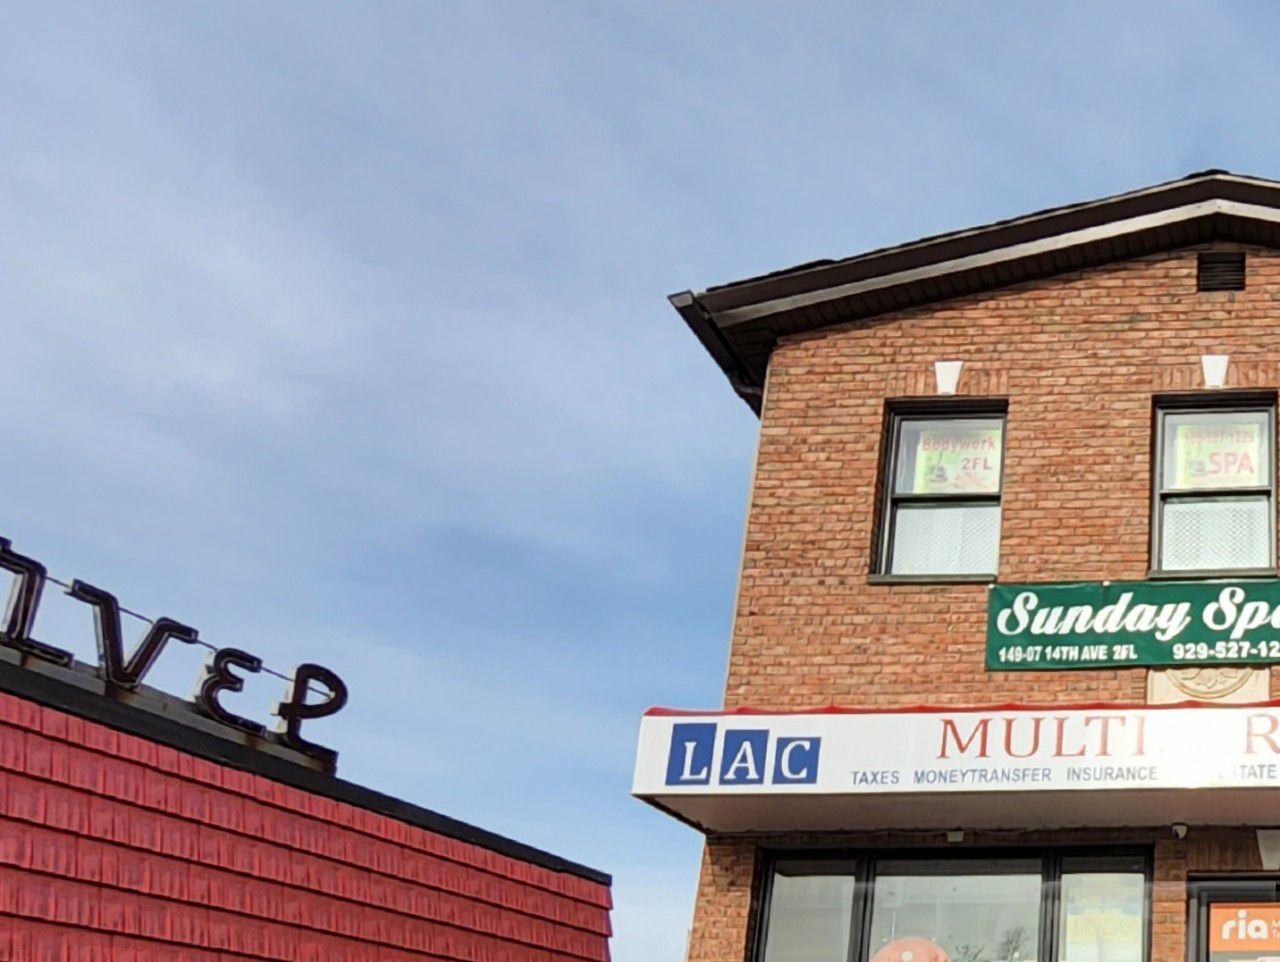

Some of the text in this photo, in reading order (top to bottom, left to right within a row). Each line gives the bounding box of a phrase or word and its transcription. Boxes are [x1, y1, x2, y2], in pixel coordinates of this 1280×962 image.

[961, 457, 993, 471] 2FL
[1209, 450, 1255, 474] SPA
[996, 591, 1192, 642] Sunday
[998, 645, 1043, 662] 149-07
[1045, 645, 1079, 661] 14TH
[1080, 645, 1108, 661] AVE
[937, 714, 1148, 760] MULTI
[679, 740, 811, 781] LAC
[851, 769, 900, 786] TAXES
[912, 767, 1052, 784] MONEYTRANSFER
[1066, 765, 1159, 782] INSURANCE
[1221, 908, 1269, 940] ria
